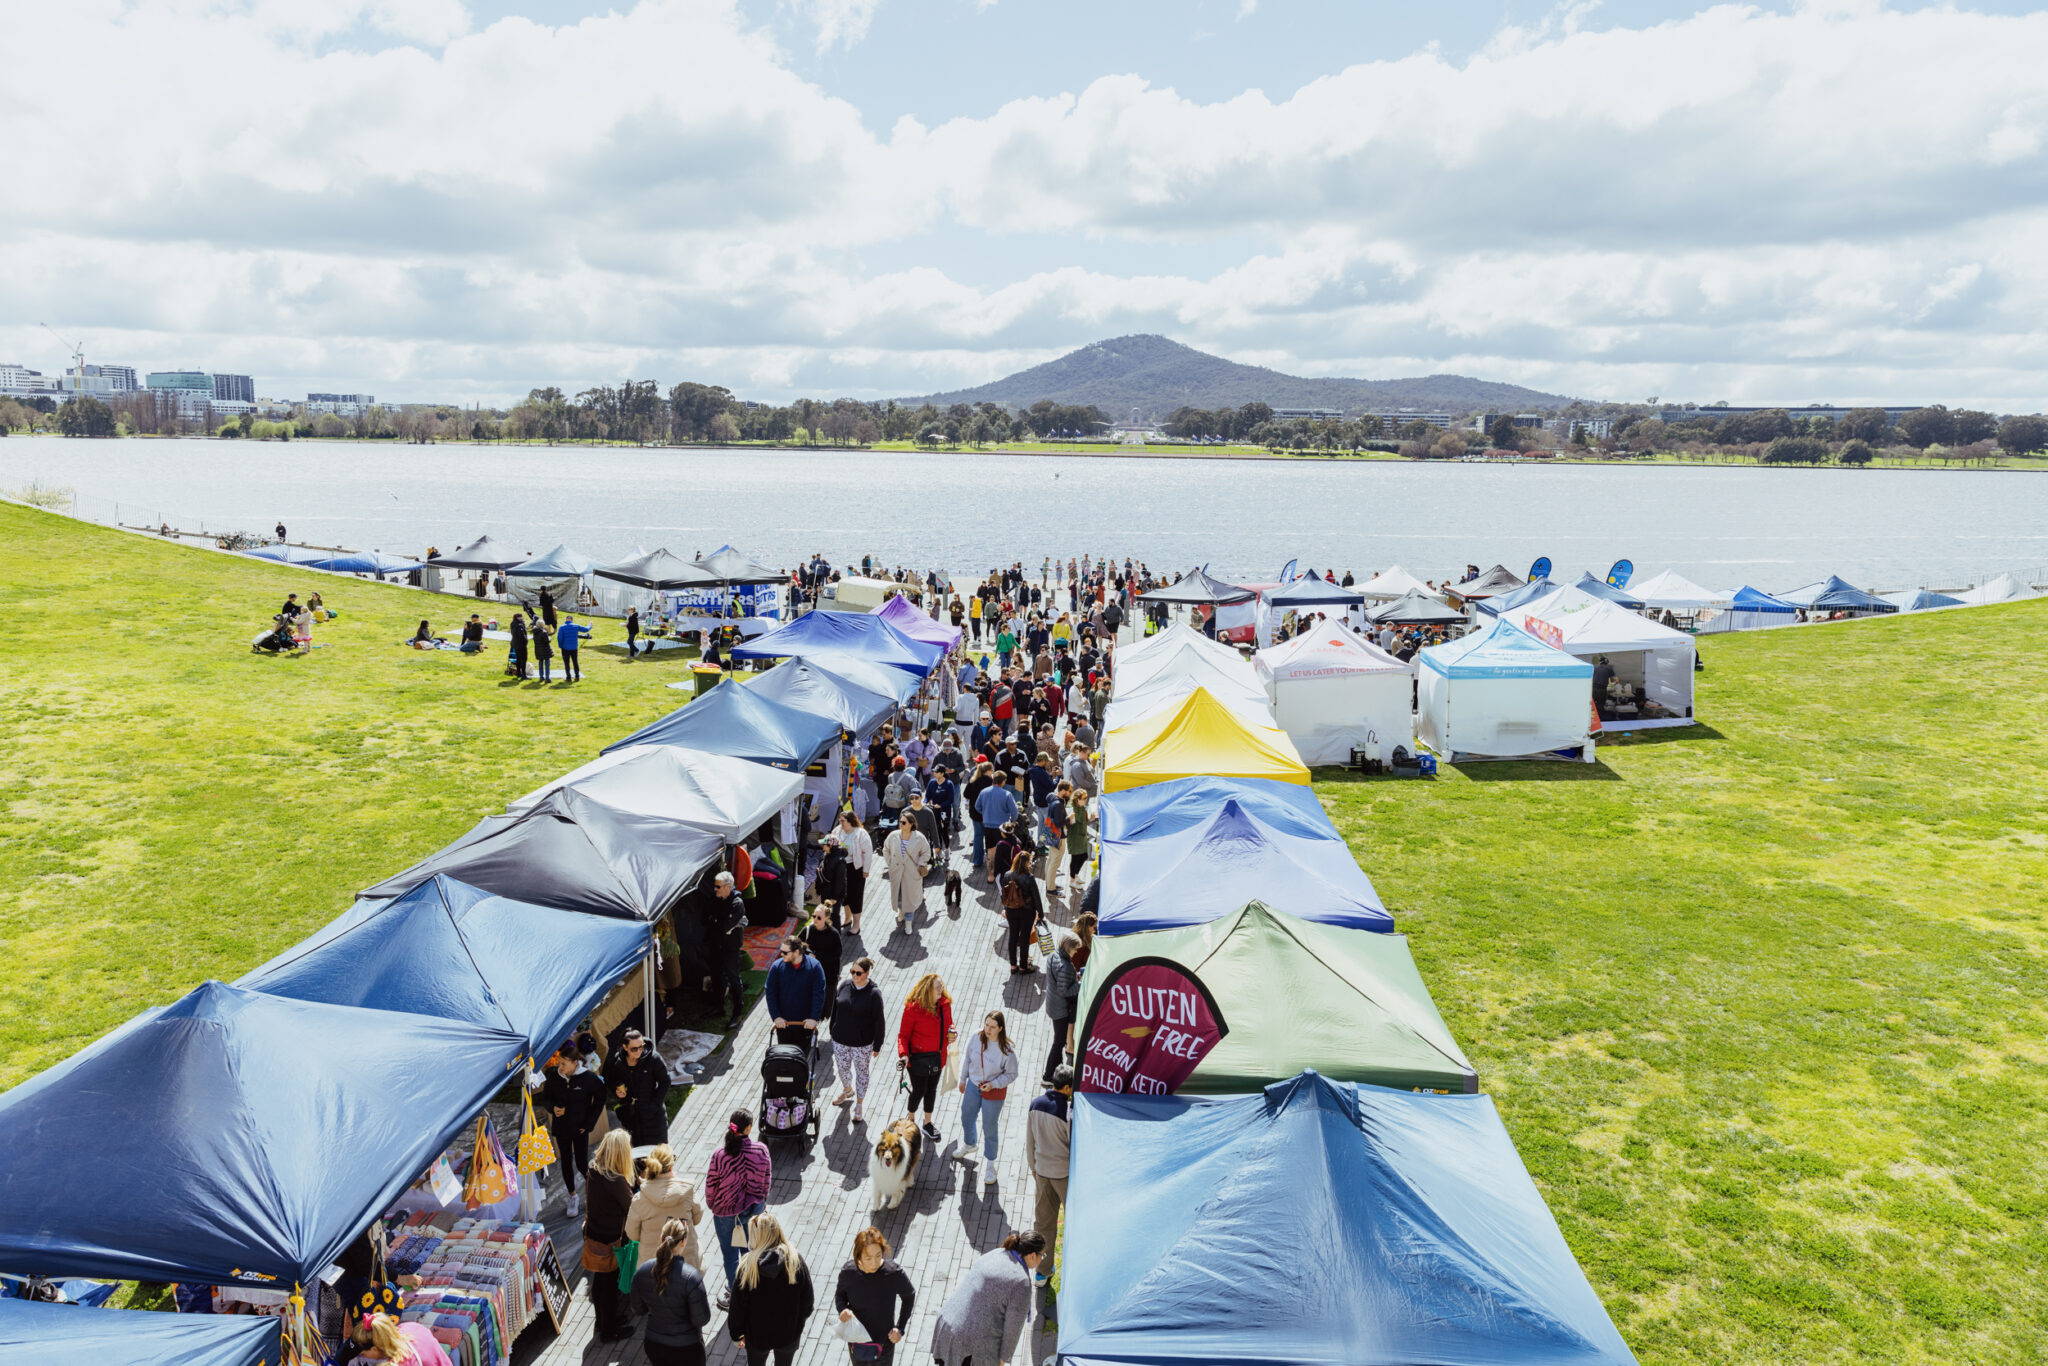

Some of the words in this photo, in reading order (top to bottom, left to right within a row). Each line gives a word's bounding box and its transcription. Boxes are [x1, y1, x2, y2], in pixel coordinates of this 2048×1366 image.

[1111, 984, 1196, 1027] GLUTEN
[1086, 1036, 1137, 1072] VEGAN
[1151, 1024, 1205, 1060] FREE
[1081, 1064, 1123, 1094] PALEO
[1130, 1072, 1167, 1096] KETO
